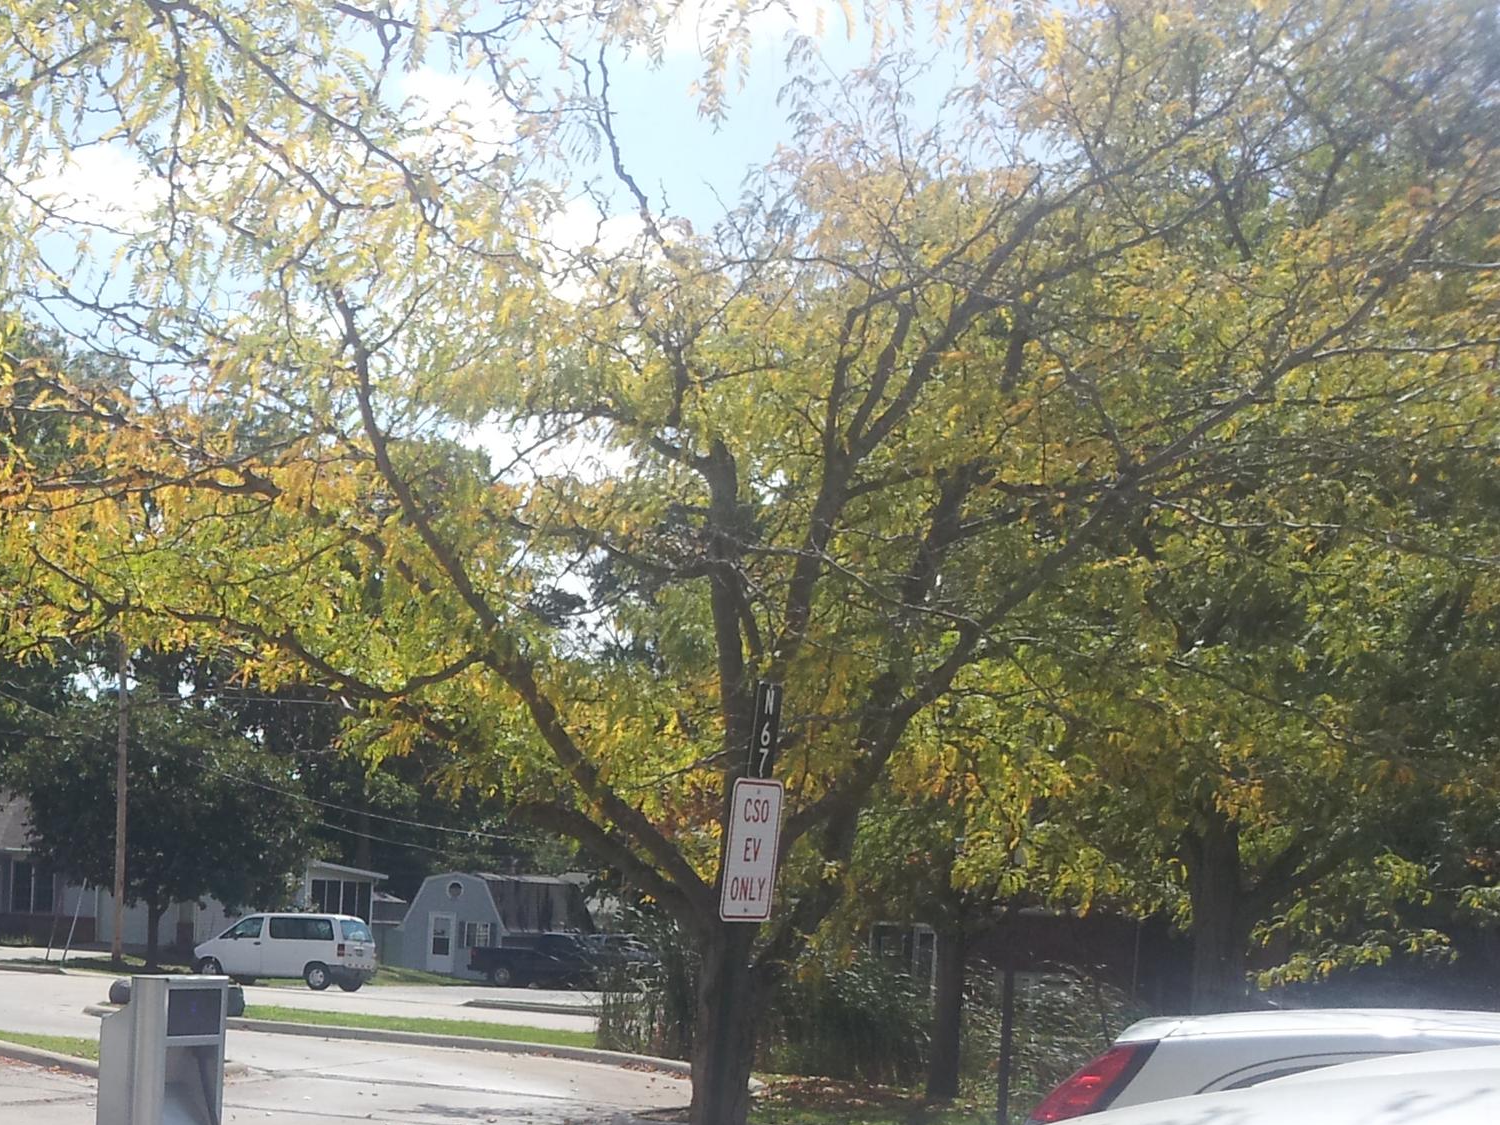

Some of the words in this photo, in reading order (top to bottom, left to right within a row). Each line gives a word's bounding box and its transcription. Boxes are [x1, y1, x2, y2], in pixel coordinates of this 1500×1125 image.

[744, 798, 769, 823] CSO
[743, 838, 762, 862] EV
[730, 876, 765, 901] ONLY
